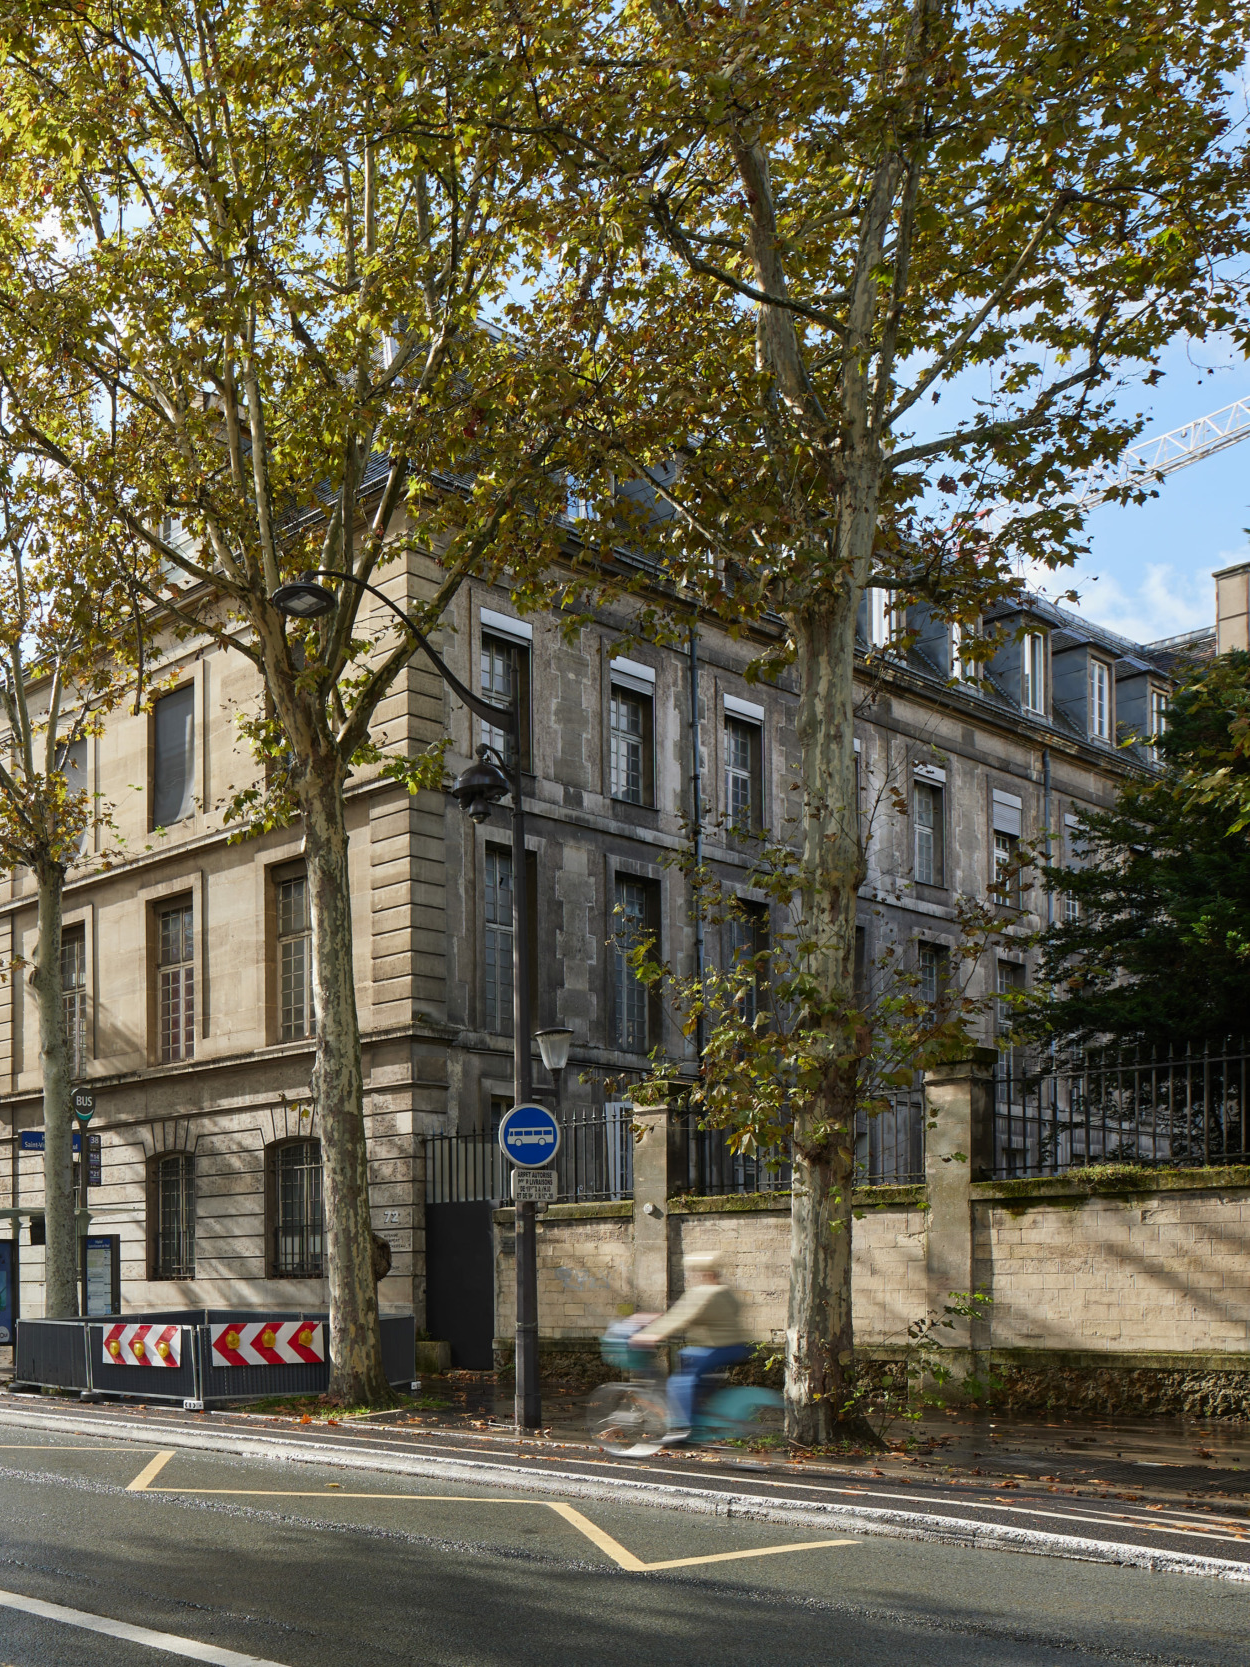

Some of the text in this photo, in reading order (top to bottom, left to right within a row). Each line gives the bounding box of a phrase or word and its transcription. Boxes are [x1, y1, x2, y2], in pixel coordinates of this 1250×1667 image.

[76, 1096, 93, 1106] BUS
[90, 1136, 99, 1144] 38
[384, 1210, 399, 1224] 72
